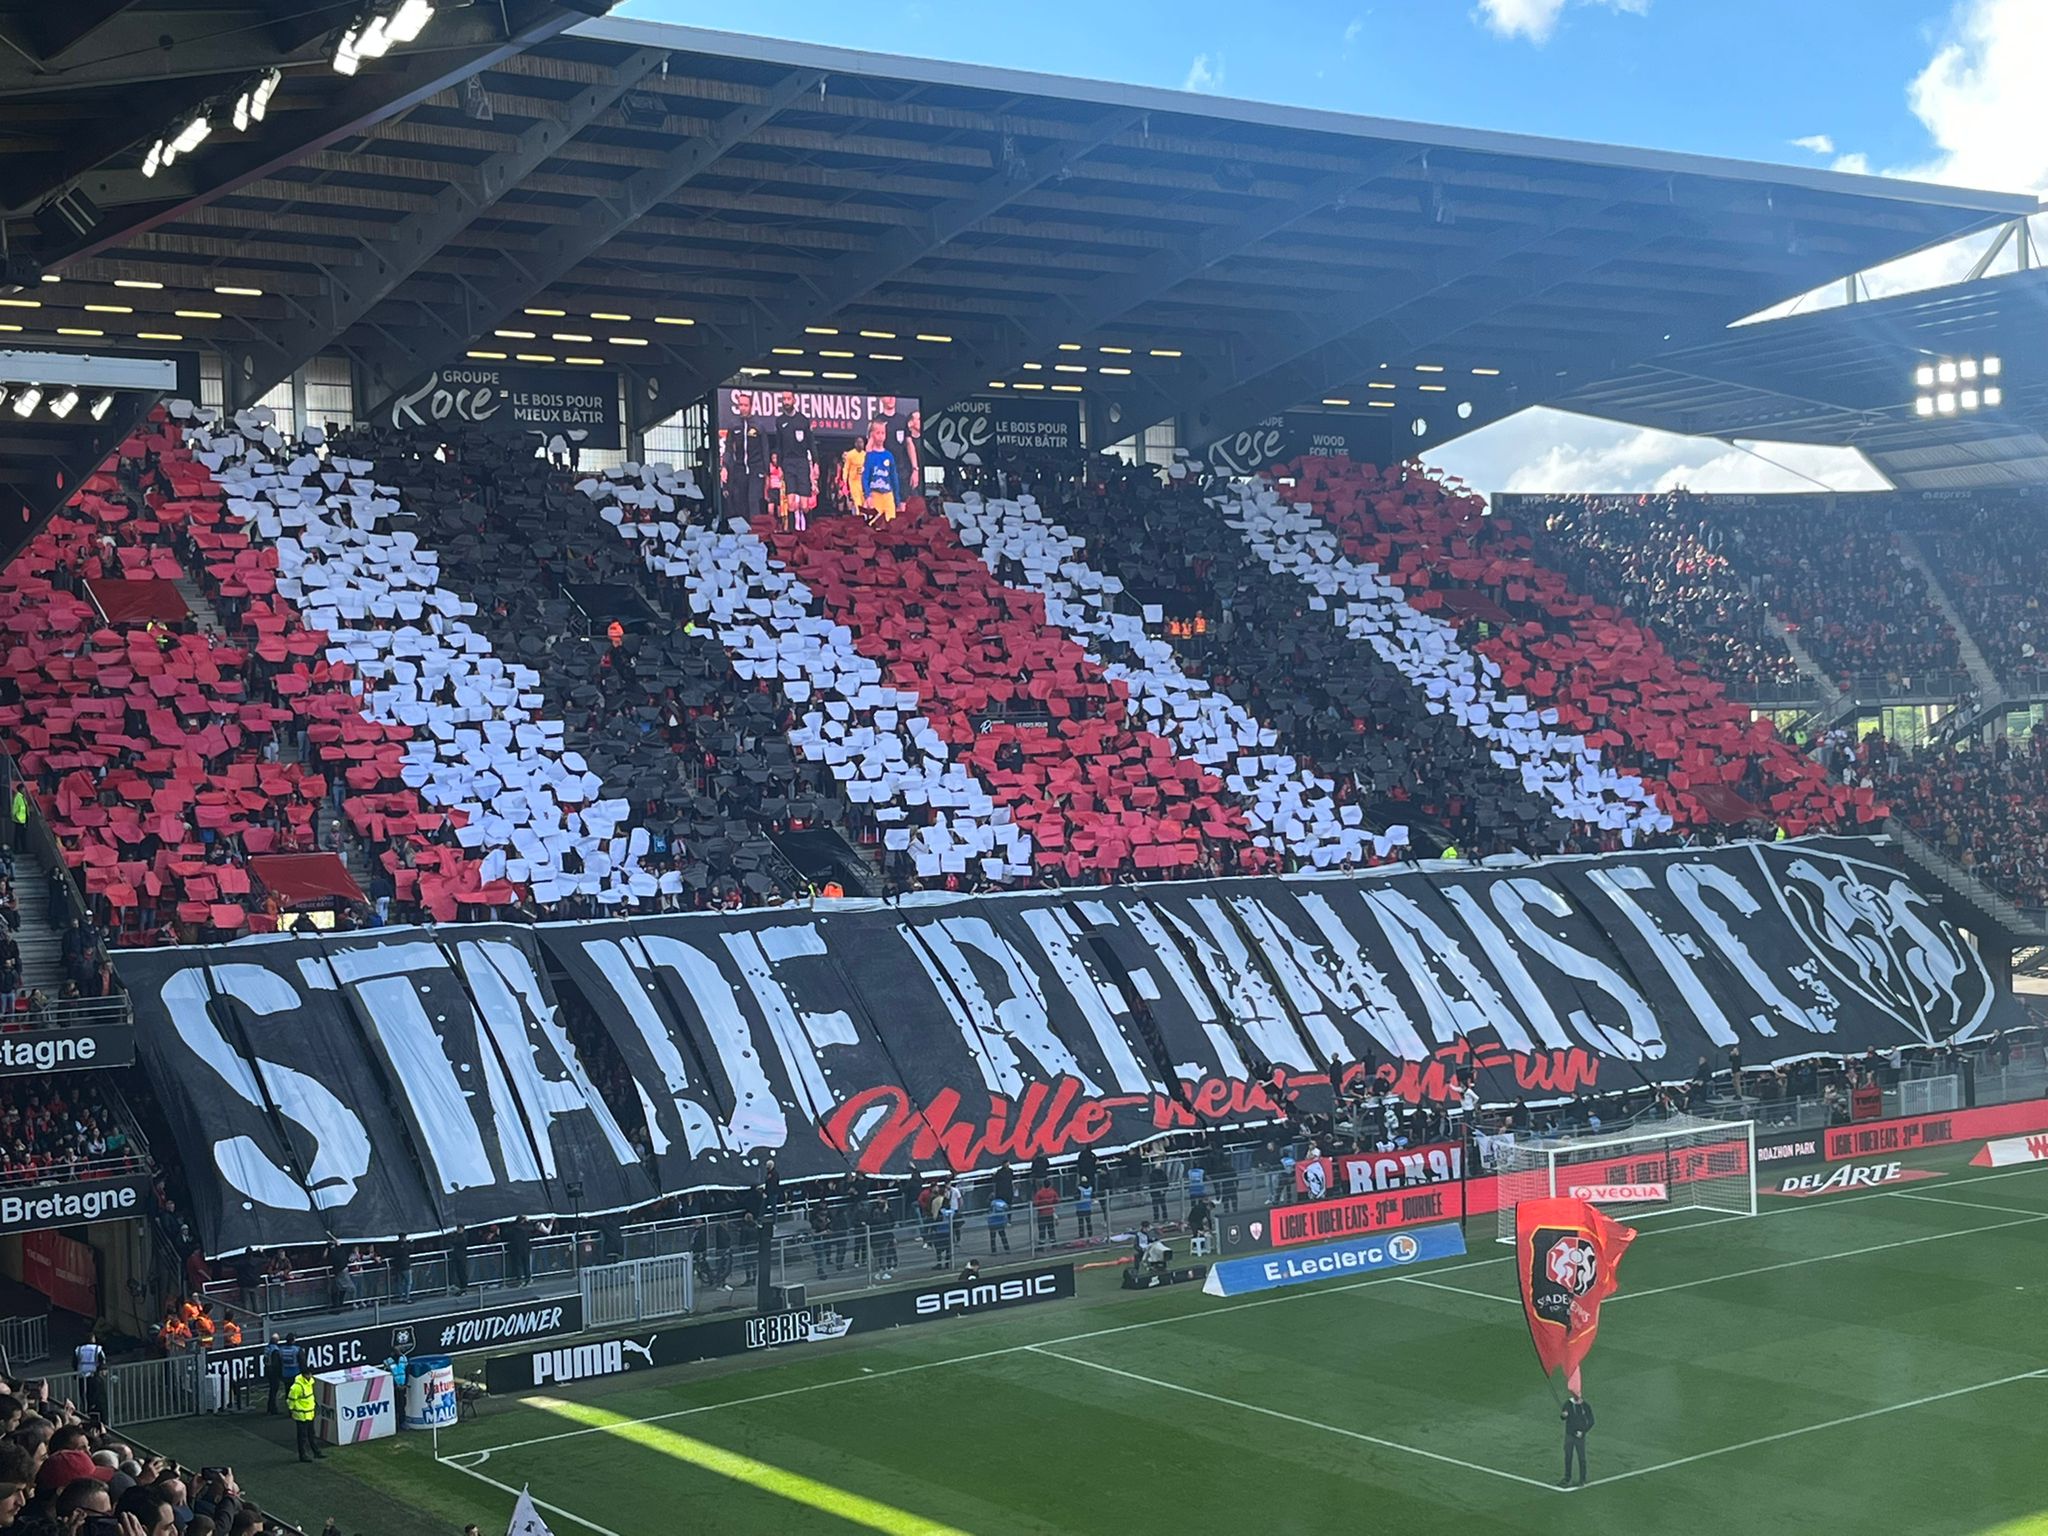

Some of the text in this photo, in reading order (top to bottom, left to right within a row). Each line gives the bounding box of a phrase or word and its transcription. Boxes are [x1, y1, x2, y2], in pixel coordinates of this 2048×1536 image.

[443, 370, 499, 384] GROUPE
[513, 394, 603, 409] LE BOIS POUR
[514, 408, 604, 423] MIEUX BÂTIR
[996, 421, 1068, 435] LE BOIS POUR
[1035, 434, 1068, 448] BÂTIR
[1312, 434, 1345, 446] WOOD
[0, 1037, 96, 1069] tagne
[160, 921, 860, 1211] STADE
[896, 877, 1667, 1101] RENNAIS
[1758, 1141, 1816, 1161] ROAZHON PARK
[1597, 1186, 1661, 1199] VEOLIA
[1, 1187, 136, 1223] Bretagne
[1280, 1212, 1308, 1240] LIGUE
[1317, 1208, 1343, 1234] UBER
[1345, 1203, 1369, 1230] EATS
[916, 1275, 1057, 1314] SAMSIC
[440, 1306, 562, 1346] #TOUTDONNER
[745, 1310, 810, 1349] LE BRIS
[533, 1342, 623, 1385] PUMA
[356, 1400, 390, 1419] BWT
[425, 1405, 457, 1424] MALO
